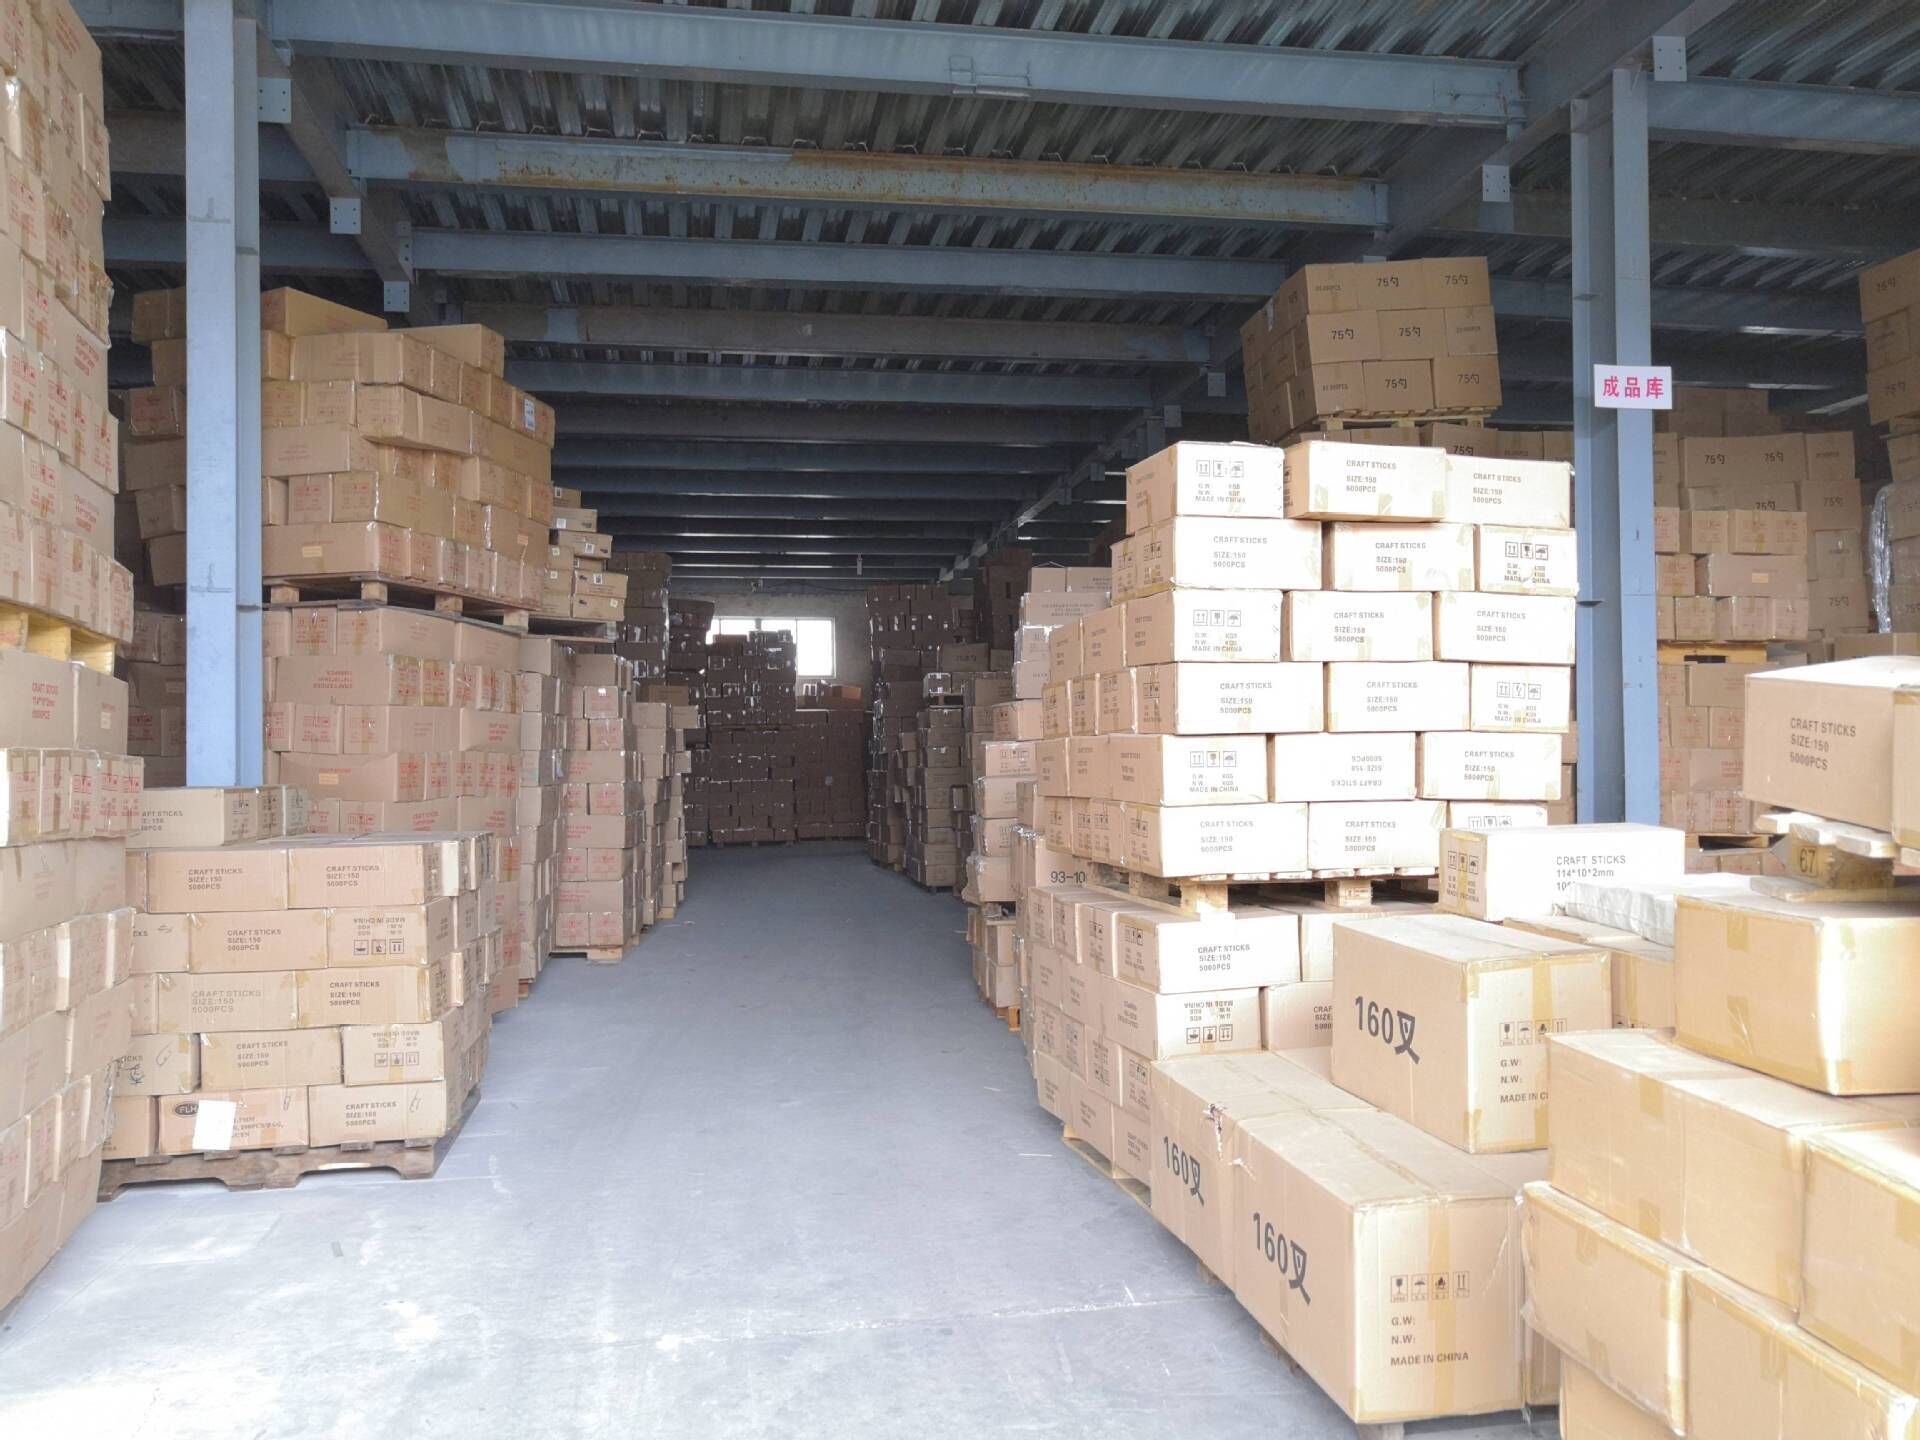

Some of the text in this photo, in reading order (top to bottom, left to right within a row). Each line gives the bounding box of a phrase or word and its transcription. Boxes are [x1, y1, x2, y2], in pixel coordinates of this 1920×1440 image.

[1376, 276, 1399, 287] 75勺
[1331, 328, 1354, 339] 75勺
[1399, 326, 1421, 337] 75勺
[1385, 378, 1407, 389] 75勺
[1602, 375, 1664, 399] 成品库
[1346, 460, 1397, 470] CRAFT STICKS
[1473, 473, 1522, 483] CRAFT STICKS
[1213, 536, 1268, 545] CRAFT STICKS
[1476, 610, 1499, 618] CRAFT
[1220, 682, 1244, 690] CRAFT
[1791, 717, 1857, 738] CRAFT STICKS
[1791, 734, 1830, 752] SIZE:150
[1790, 752, 1828, 771] 5000PCS
[1200, 820, 1224, 828] CRAFT
[1556, 855, 1626, 865] CRAFT STICKS
[1198, 943, 1250, 953] CRAFT STICKS
[192, 990, 224, 998] CRAFT
[1500, 1093, 1527, 1103] MADE
[1529, 1092, 1538, 1101] IN
[370, 1101, 397, 1109] STICKS
[1390, 1352, 1469, 1366] MADE IN CHINA
